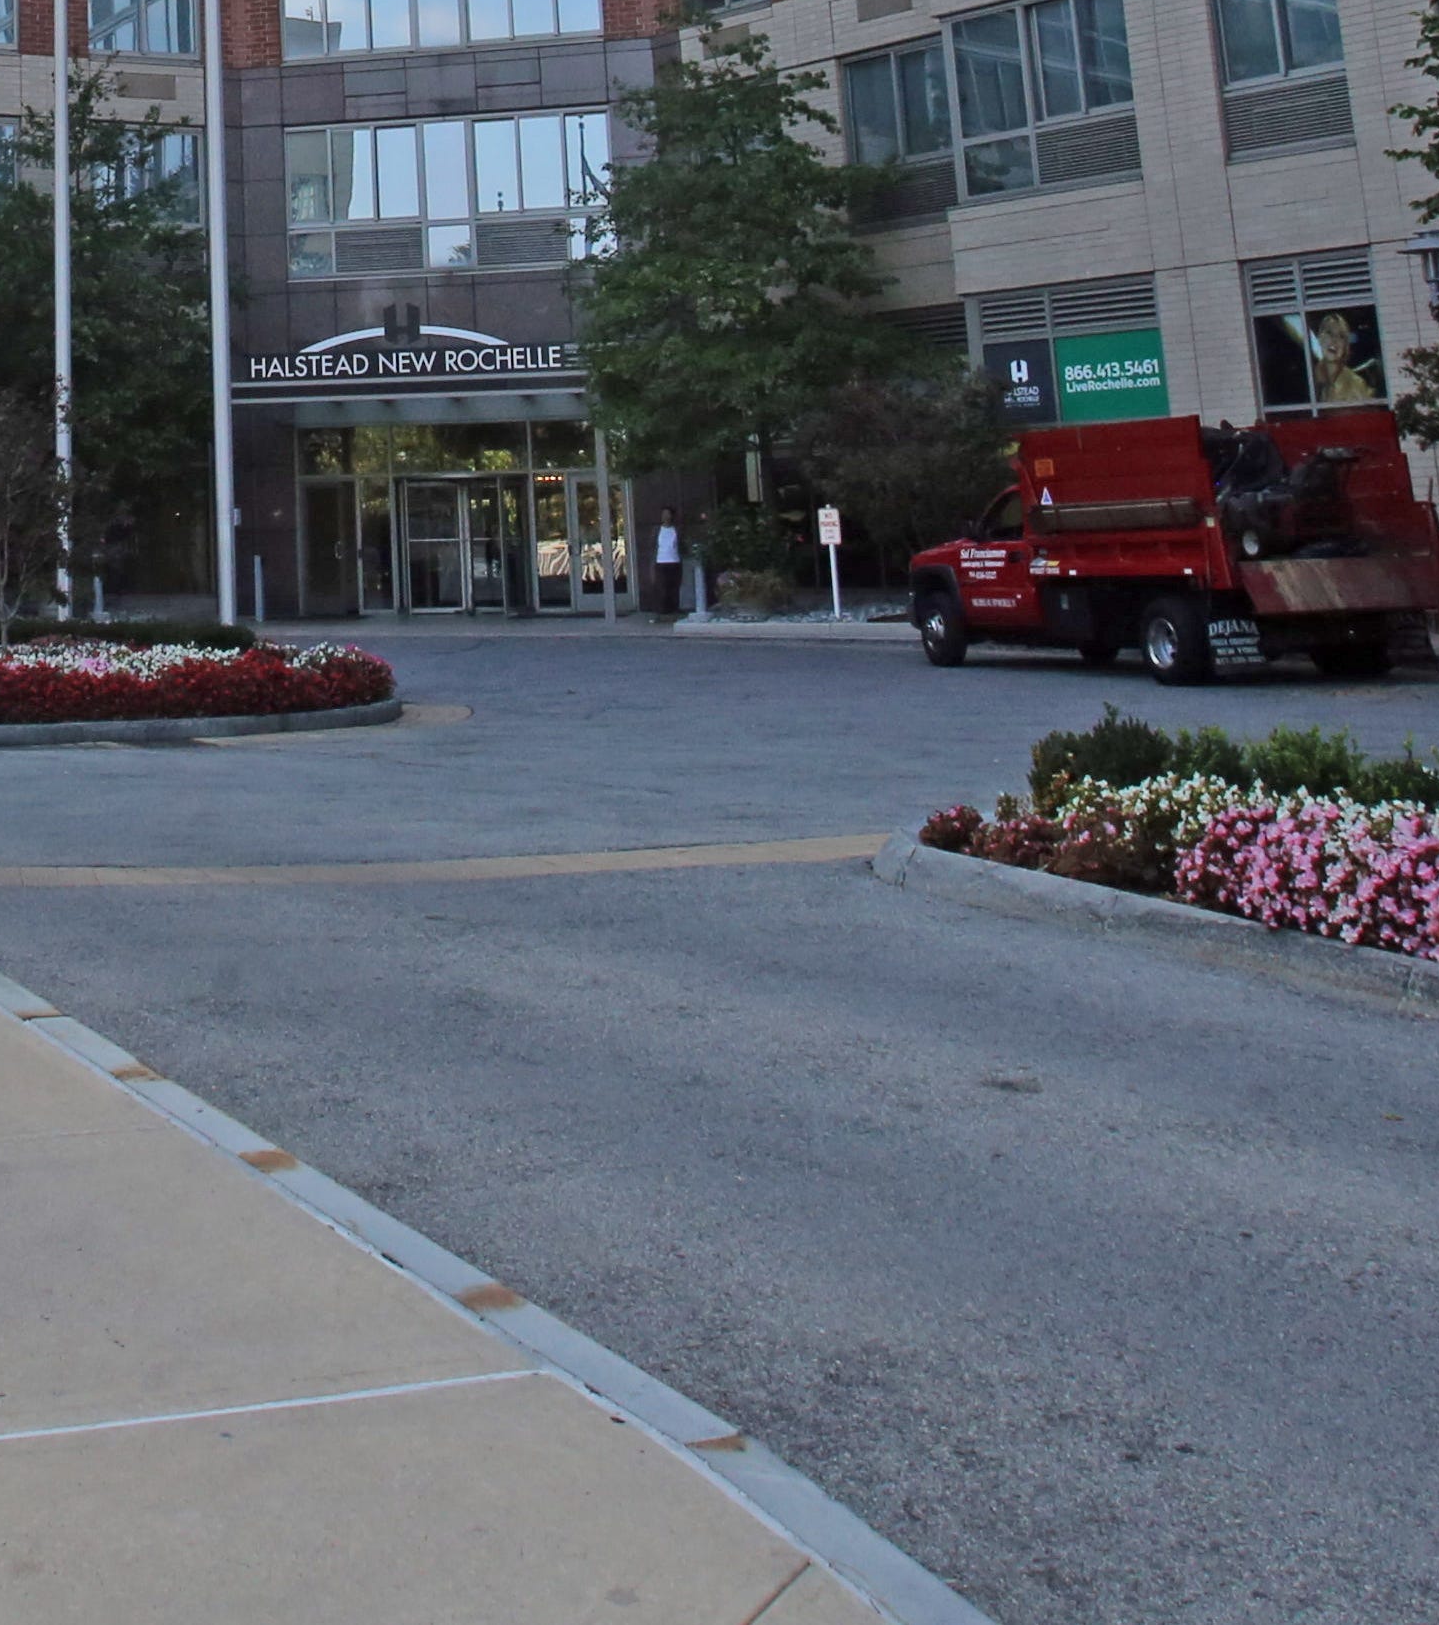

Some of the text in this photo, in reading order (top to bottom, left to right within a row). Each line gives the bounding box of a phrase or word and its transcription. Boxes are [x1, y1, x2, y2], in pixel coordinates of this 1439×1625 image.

[250, 345, 562, 379] HALSTEAD NEW ROCHELLE
[1064, 358, 1160, 381] 866.413.5461
[1065, 376, 1161, 394] LiveRochelle.com
